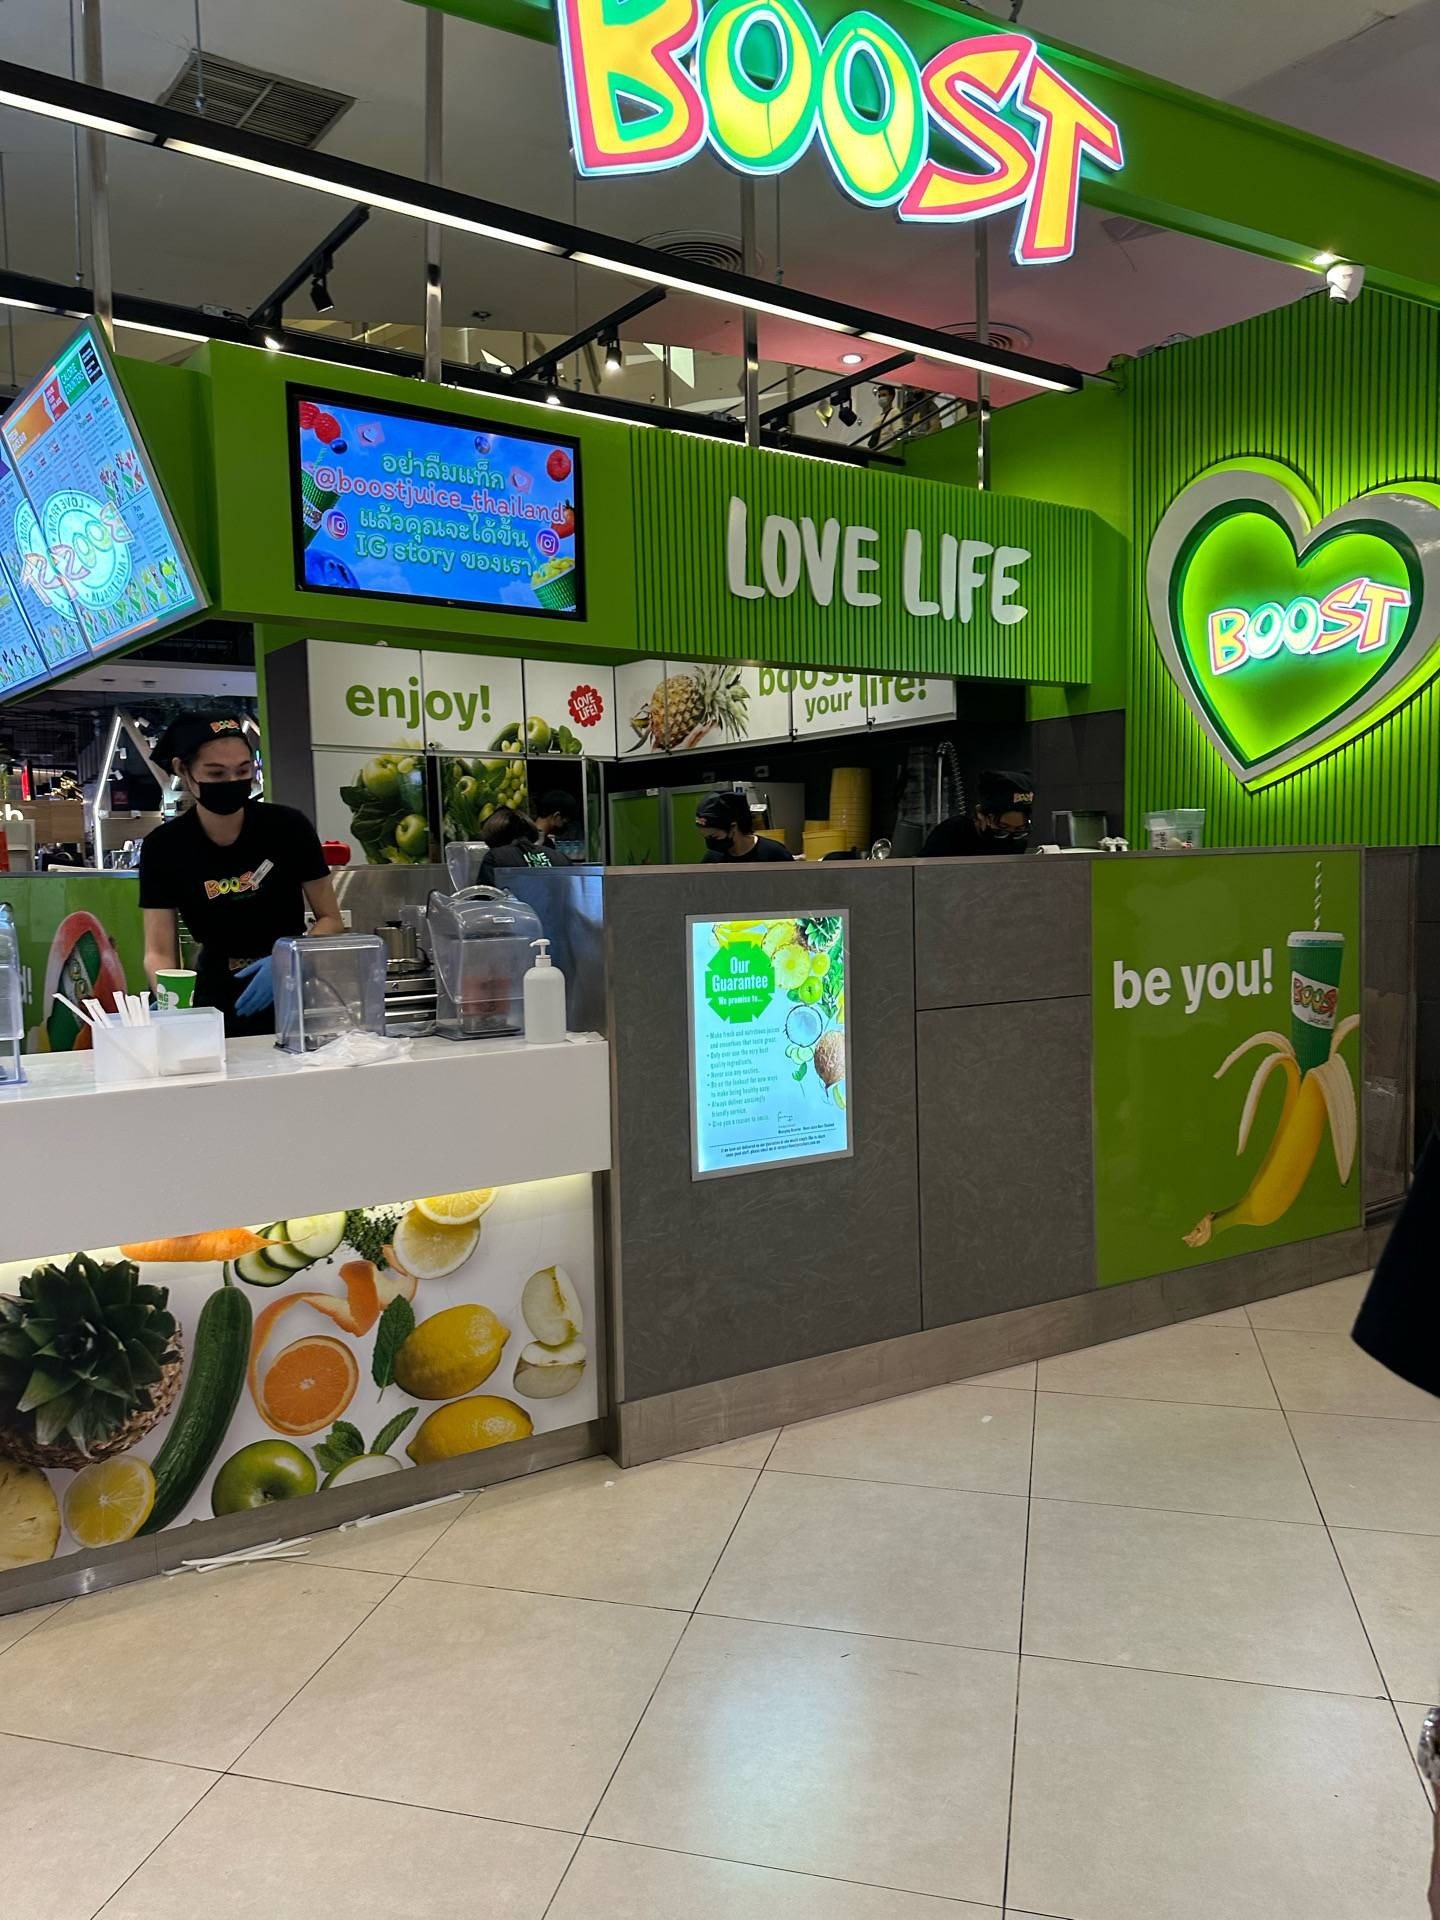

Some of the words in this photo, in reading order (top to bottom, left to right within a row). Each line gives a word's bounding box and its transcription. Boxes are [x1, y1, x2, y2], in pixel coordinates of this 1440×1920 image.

[558, 0, 1126, 266] BOOST
[382, 450, 505, 490] อย่าลืมแท็ก
[314, 467, 566, 525] @boostjuice_thailand
[359, 504, 530, 550] แล้วคุณจะได้ขึ้น
[355, 533, 387, 559] IG
[394, 541, 456, 573] story
[460, 552, 533, 577] ของเรา
[727, 495, 882, 607] LOVE
[903, 528, 1032, 625] LIFE
[1208, 577, 1412, 675] BOOST
[345, 676, 492, 732] enjoy!
[573, 692, 596, 710] LOVE
[578, 702, 599, 720] LIFE!
[805, 691, 852, 723] your
[712, 974, 768, 992] Guarantee
[730, 956, 750, 974] Our
[1113, 960, 1171, 1009] be
[1180, 948, 1273, 1014] you!
